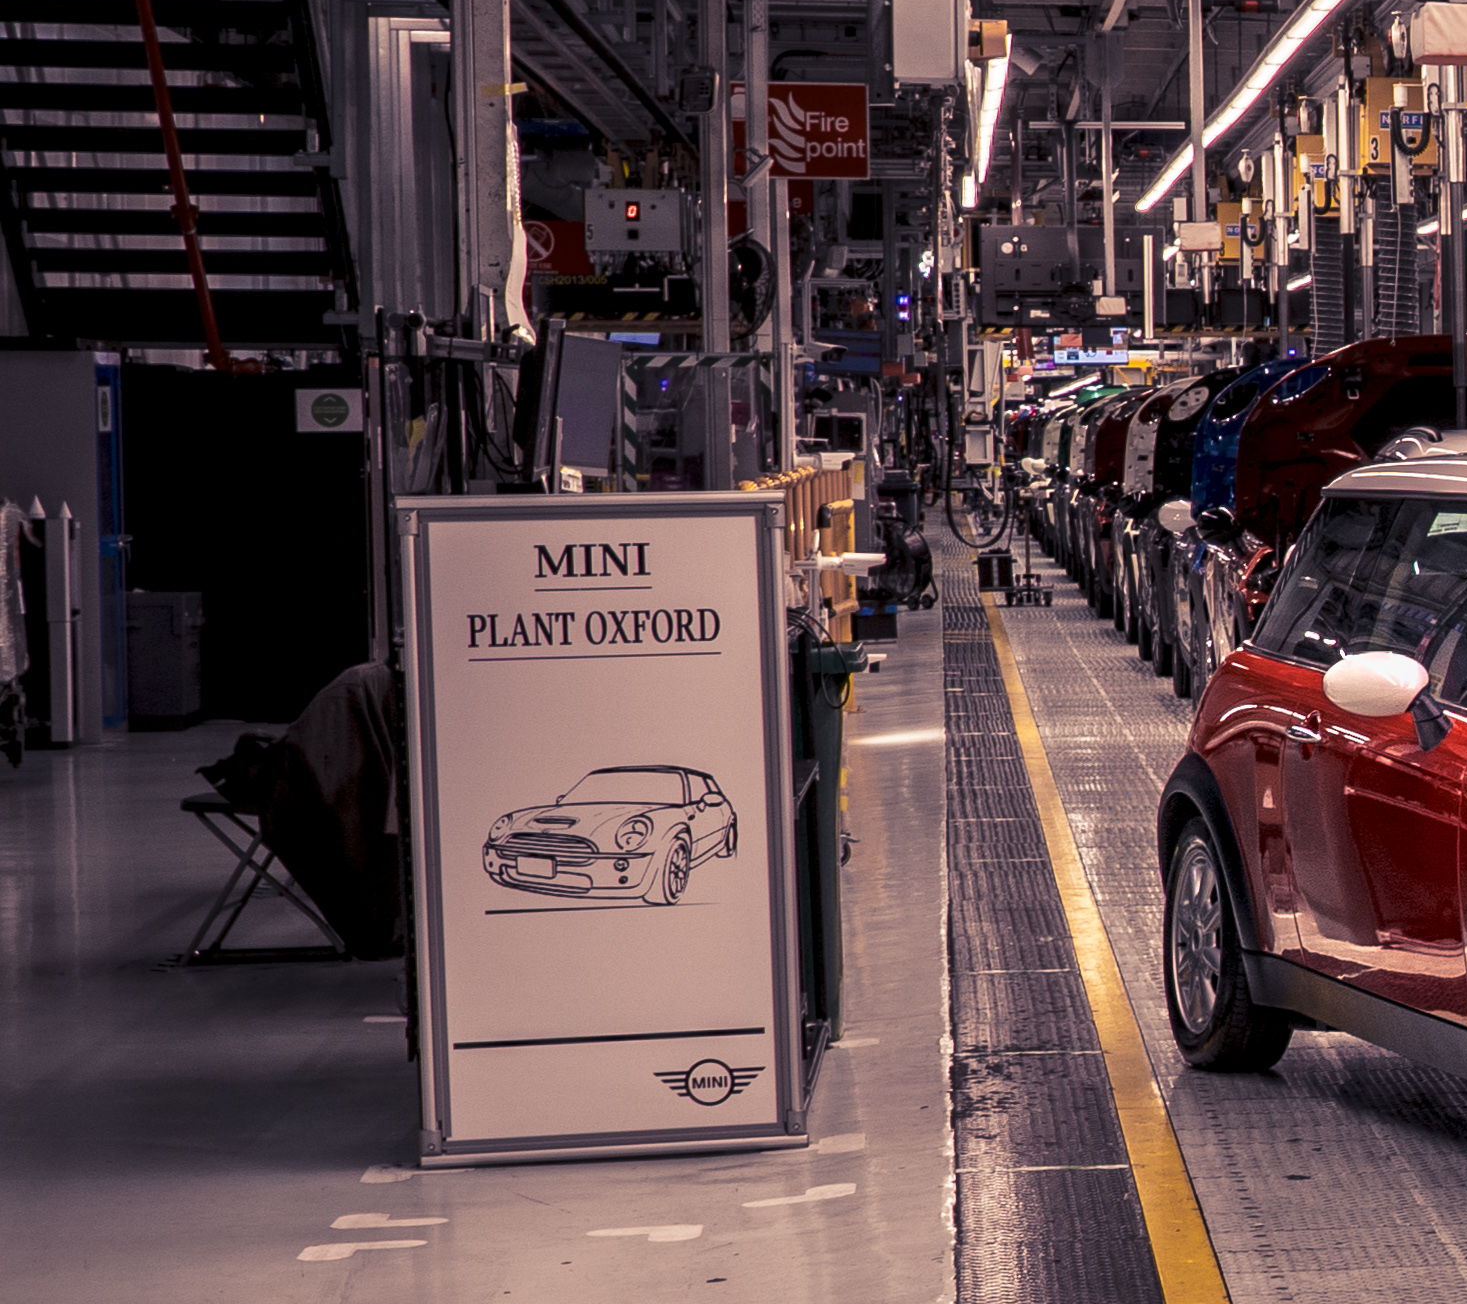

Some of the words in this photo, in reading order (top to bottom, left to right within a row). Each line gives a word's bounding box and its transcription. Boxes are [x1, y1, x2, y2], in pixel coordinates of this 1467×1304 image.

[805, 111, 849, 132] Fire
[1382, 115, 1424, 125] NRFI
[806, 137, 866, 163] point
[1371, 138, 1379, 161] 3
[533, 542, 651, 579] MINI
[466, 611, 576, 649] PLANT
[584, 608, 721, 646] OXFORD
[691, 1075, 728, 1090] MINI
